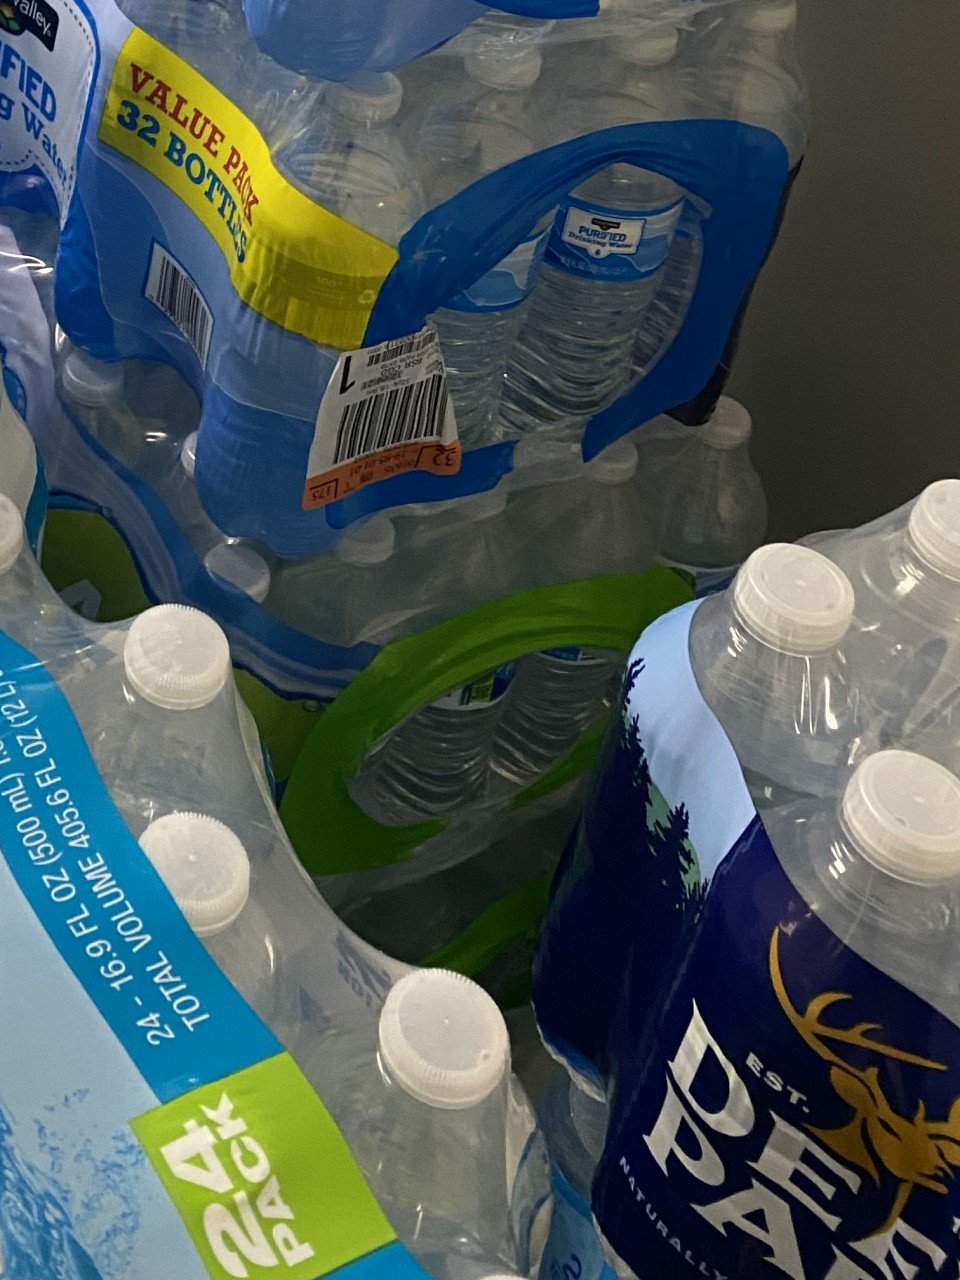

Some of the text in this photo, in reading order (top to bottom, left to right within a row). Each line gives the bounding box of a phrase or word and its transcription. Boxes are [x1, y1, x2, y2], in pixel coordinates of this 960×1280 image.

[130, 63, 259, 227] VALUE PACK
[116, 99, 248, 264] 32 BOTTLES
[578, 225, 627, 242] PURIFIED
[0, 698, 38, 728] (12
[16, 728, 48, 758] OZ
[34, 757, 62, 789] FL
[16, 816, 63, 866] (500
[45, 788, 90, 849] 405.6
[41, 867, 77, 903] OZ
[77, 851, 152, 954] VOLUME
[65, 902, 99, 938] FL
[85, 938, 133, 992] 16.9
[145, 950, 210, 1032] TOTAL
[136, 1011, 176, 1046] 24
[745, 1051, 810, 1114] EST.
[667, 997, 960, 1280] DEE
[160, 1118, 280, 1279] 24
[198, 1091, 316, 1267] PACK
